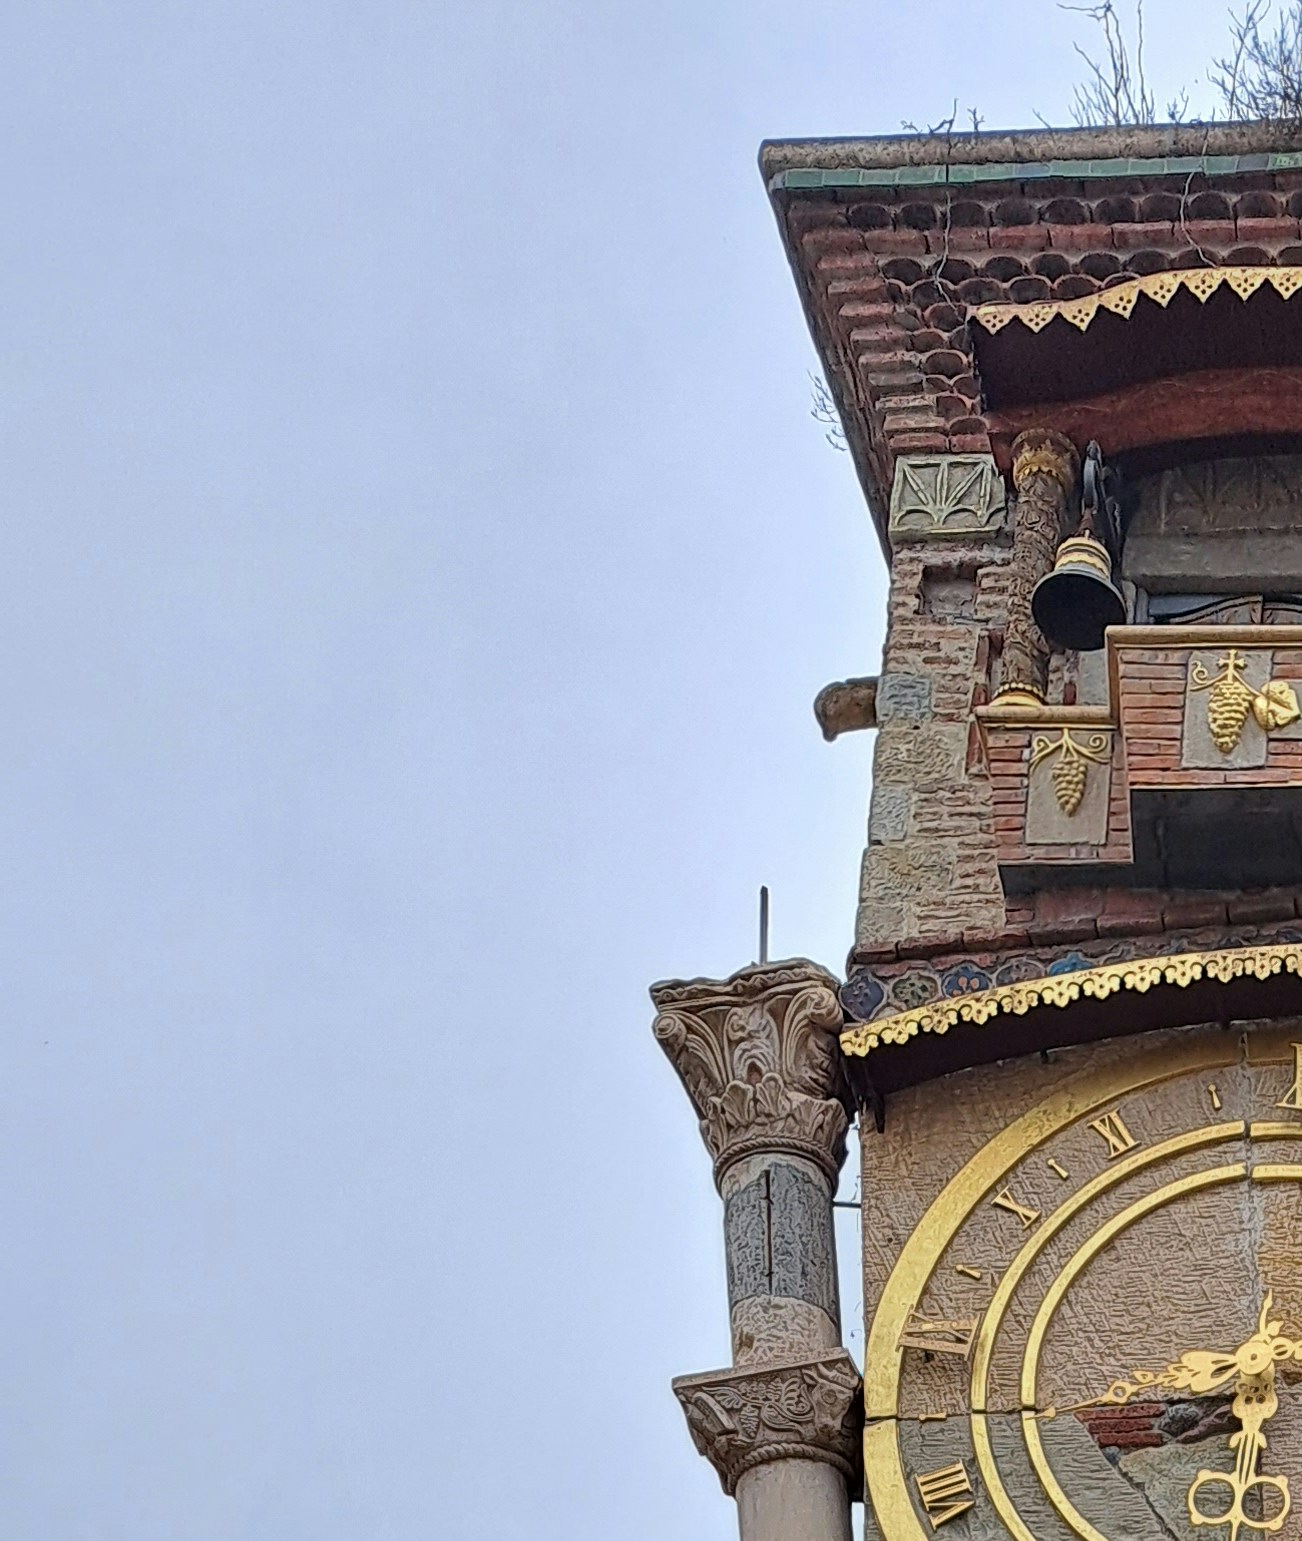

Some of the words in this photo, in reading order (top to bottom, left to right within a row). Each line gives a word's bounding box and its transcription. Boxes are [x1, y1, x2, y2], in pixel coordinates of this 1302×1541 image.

[1087, 1109, 1140, 1160] XI
[992, 1186, 1041, 1231] X
[896, 1304, 982, 1361] IX
[915, 1460, 976, 1531] VIII
